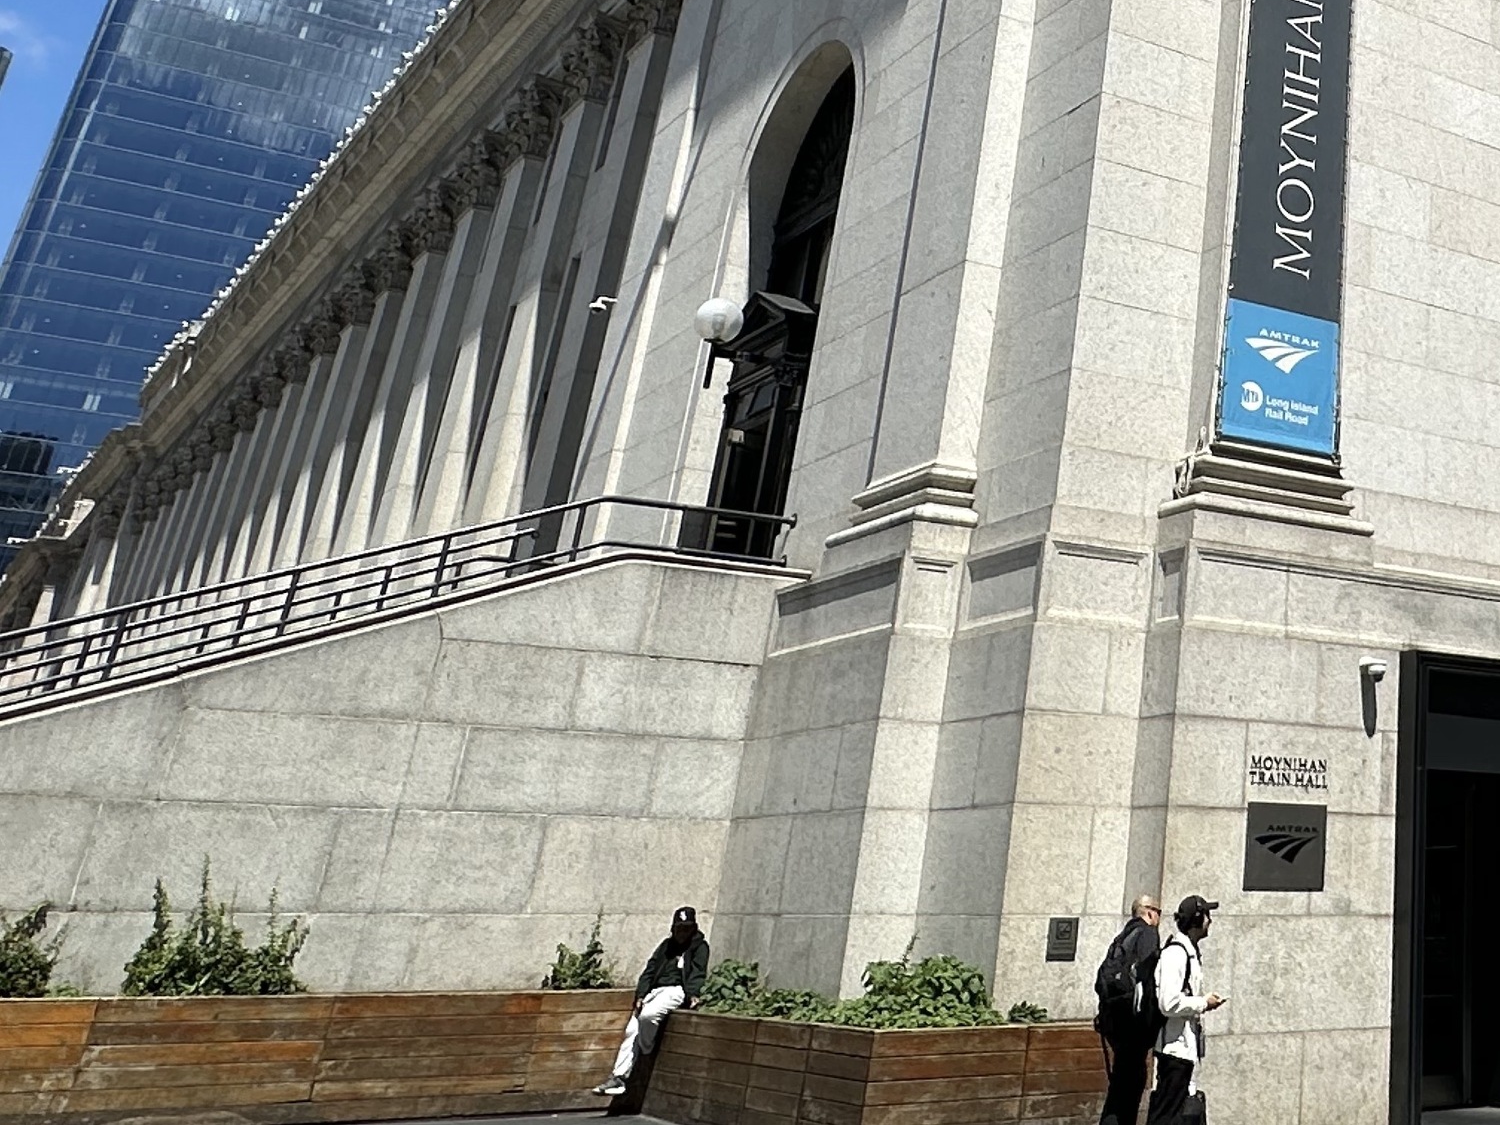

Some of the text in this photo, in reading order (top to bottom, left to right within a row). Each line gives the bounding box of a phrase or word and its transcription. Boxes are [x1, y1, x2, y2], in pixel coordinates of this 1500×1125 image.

[1258, 327, 1320, 349] AMTRAK
[1266, 395, 1290, 411] Long
[1250, 755, 1327, 773] MOYNIHAN
[1249, 771, 1328, 789] TRAIN HALL
[1266, 824, 1320, 833] AMTRAK
